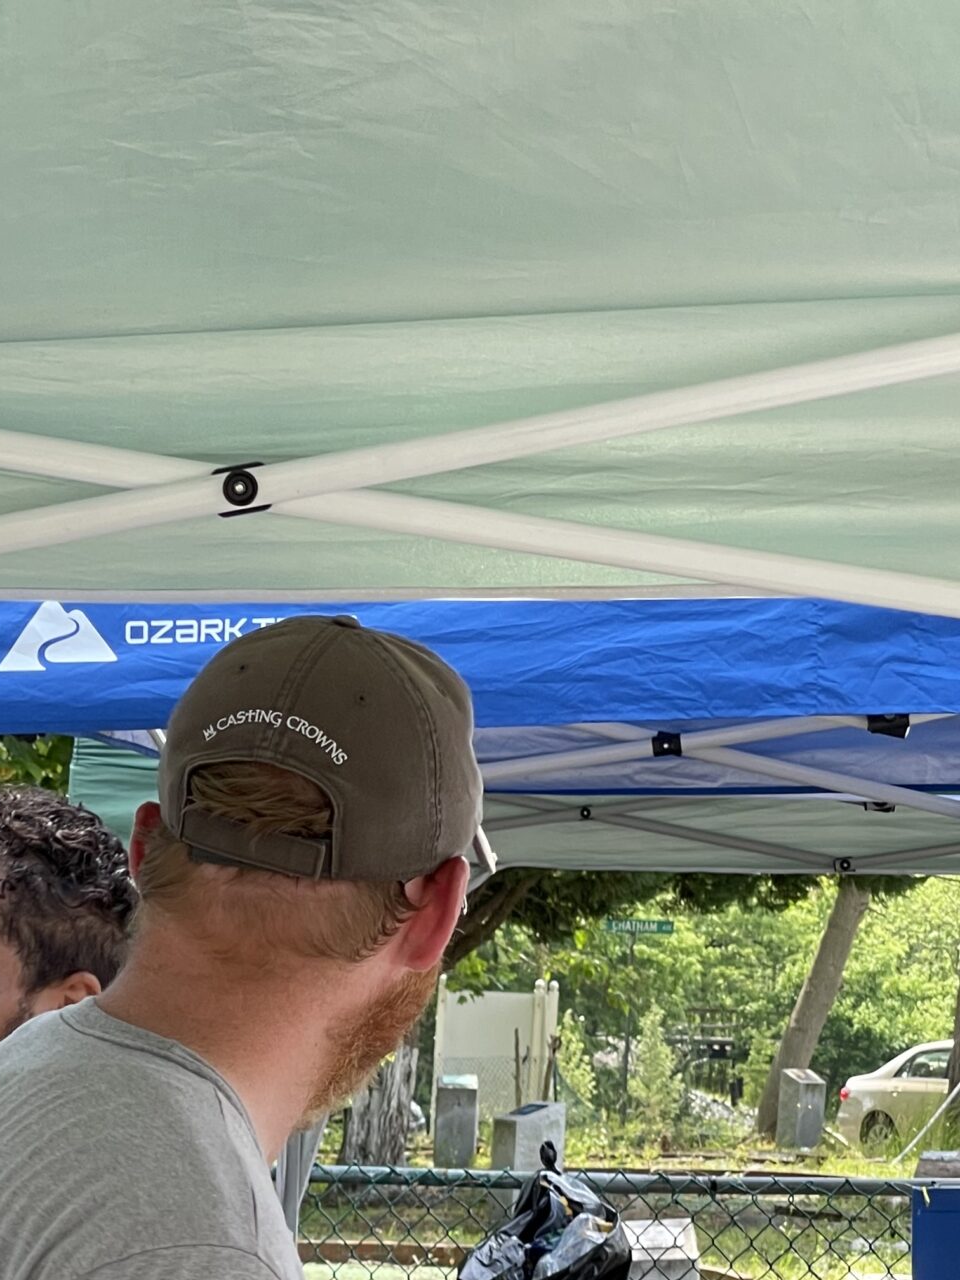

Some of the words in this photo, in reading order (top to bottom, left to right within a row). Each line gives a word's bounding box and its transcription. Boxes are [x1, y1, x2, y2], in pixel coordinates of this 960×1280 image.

[217, 709, 283, 730] CASTING
[286, 716, 348, 765] CROWNS
[612, 920, 657, 932] CHATHAM
